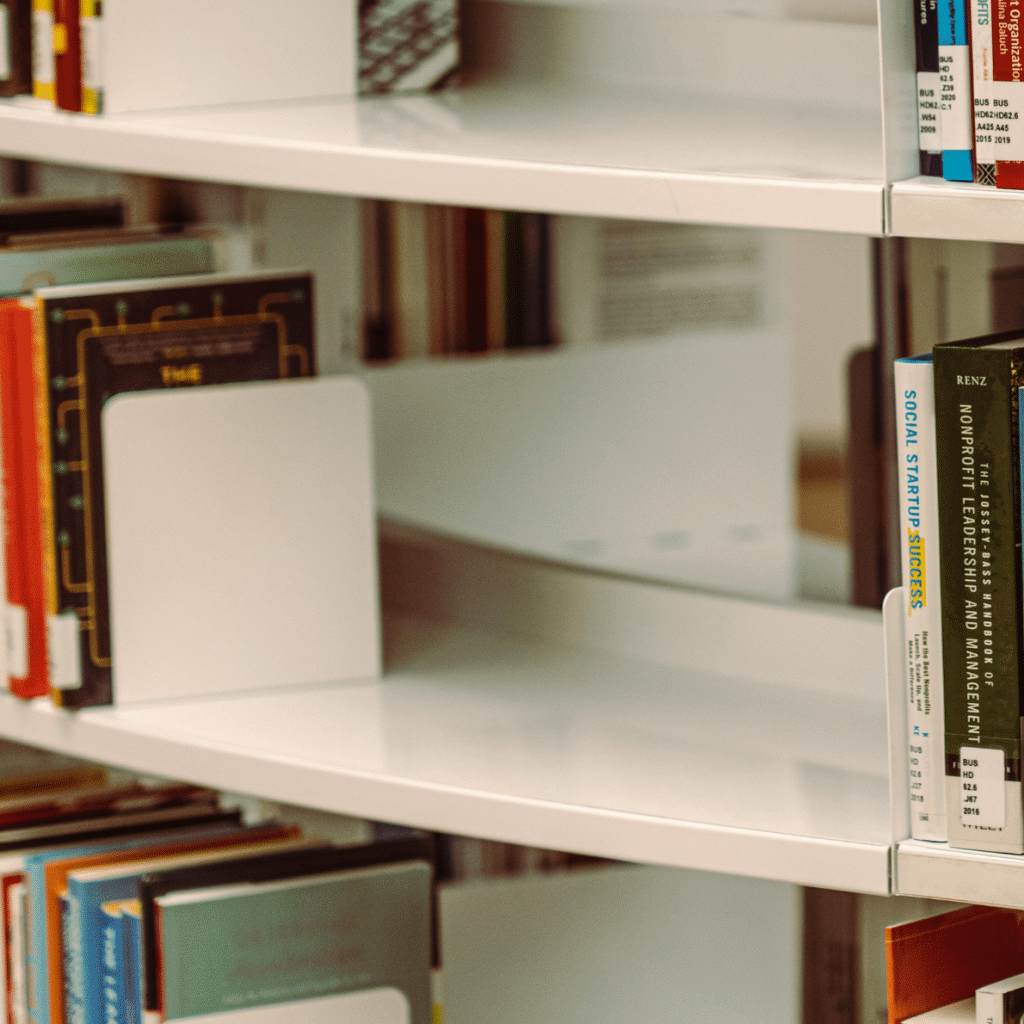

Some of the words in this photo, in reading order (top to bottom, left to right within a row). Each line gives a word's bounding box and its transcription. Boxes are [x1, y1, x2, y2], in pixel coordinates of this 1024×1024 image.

[956, 375, 987, 386] RENZ
[904, 390, 918, 448] SOCIAL
[960, 404, 974, 490] NONPROFIT
[906, 454, 920, 528] STARTUP
[980, 463, 989, 486] THE
[908, 534, 923, 609] SUCCESS
[962, 497, 977, 593] LEADERSHIP
[980, 494, 992, 586] JOSSEY-BASS
[965, 600, 978, 630] AND
[982, 593, 993, 664] HANDBOOK
[966, 638, 980, 744] MANAGEMENT
[984, 672, 994, 688] OF
